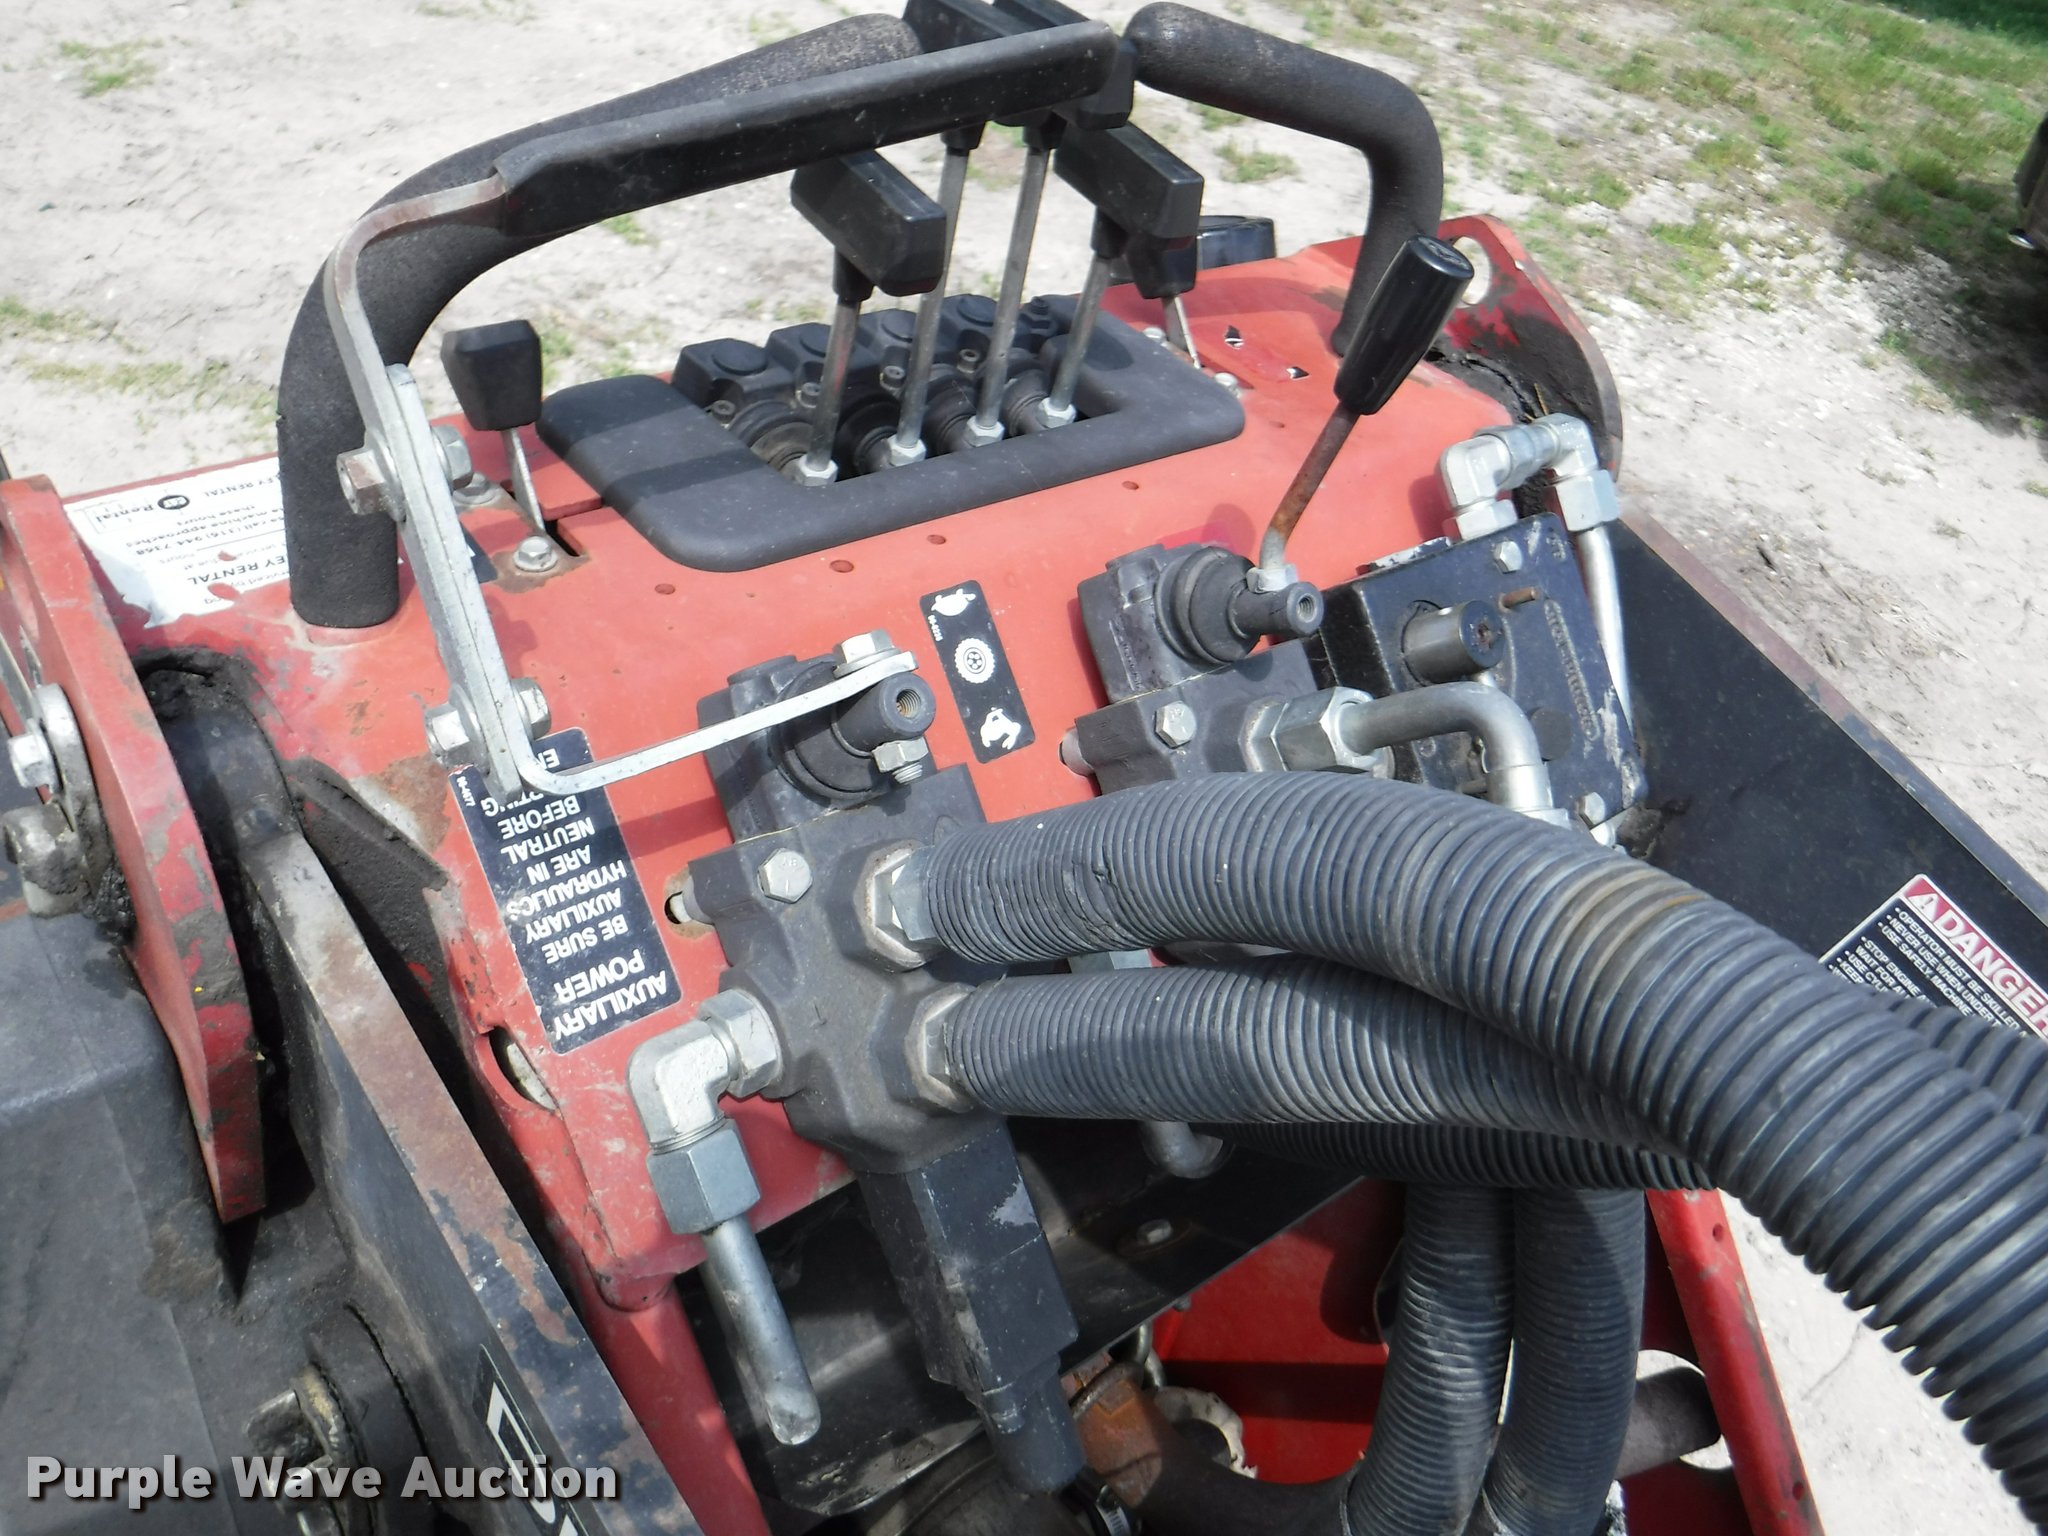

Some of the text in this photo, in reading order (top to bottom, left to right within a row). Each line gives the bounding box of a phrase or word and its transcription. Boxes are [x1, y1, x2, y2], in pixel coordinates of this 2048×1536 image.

[96, 504, 154, 522] Rental
[205, 482, 254, 497] RENTAL
[187, 555, 287, 586] EY RENTAL
[497, 795, 581, 840] BEFORE
[500, 816, 596, 865] NEUTRAL
[506, 859, 628, 921] HYDRAULICS
[526, 844, 592, 886] ARE IN
[525, 887, 622, 945] AUXILIARY
[541, 914, 629, 965] BE SURE
[553, 948, 646, 1003] POWER
[1840, 960, 1865, 985] KEEP
[1848, 953, 1869, 975] USE
[1856, 945, 1879, 968] WAIT
[1875, 966, 1897, 988] FOR
[1864, 940, 1921, 997] STOP ENGINE
[1881, 925, 1902, 947] USE
[1930, 975, 1973, 1016] MACHINE
[1889, 917, 1921, 949] NEVER
[1918, 946, 1939, 968] USE
[1936, 962, 1967, 994] WHEN
[1899, 911, 2020, 1030] OPERATOR MUST BE SKILLED
[553, 970, 668, 1041] AUXILIARY
